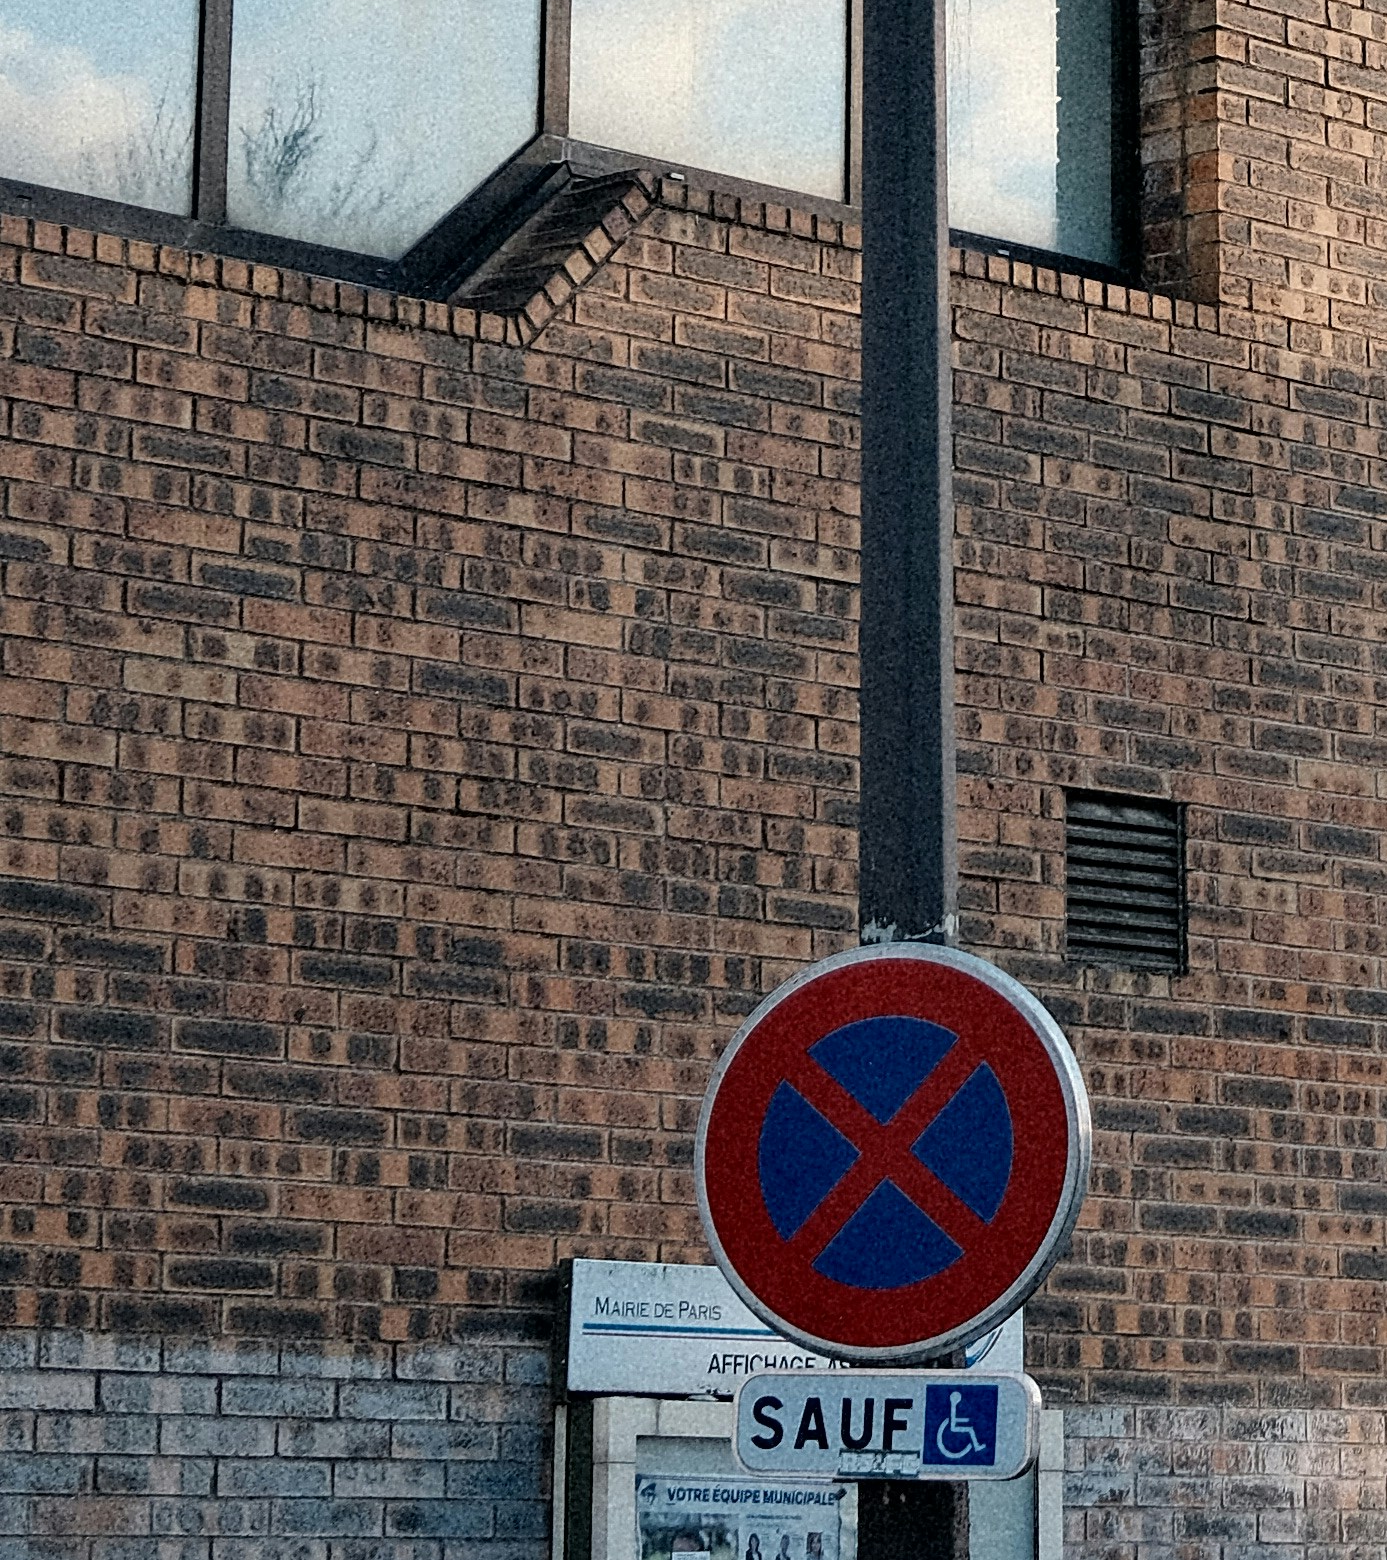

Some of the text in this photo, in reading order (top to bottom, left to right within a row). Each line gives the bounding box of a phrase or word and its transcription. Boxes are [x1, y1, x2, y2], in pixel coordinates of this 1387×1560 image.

[751, 1395, 914, 1450] SAUF
[667, 1487, 709, 1503] VOTRE
[714, 1484, 760, 1505] ÉQUIPE
[763, 1488, 836, 1507] MUNICIPALE
